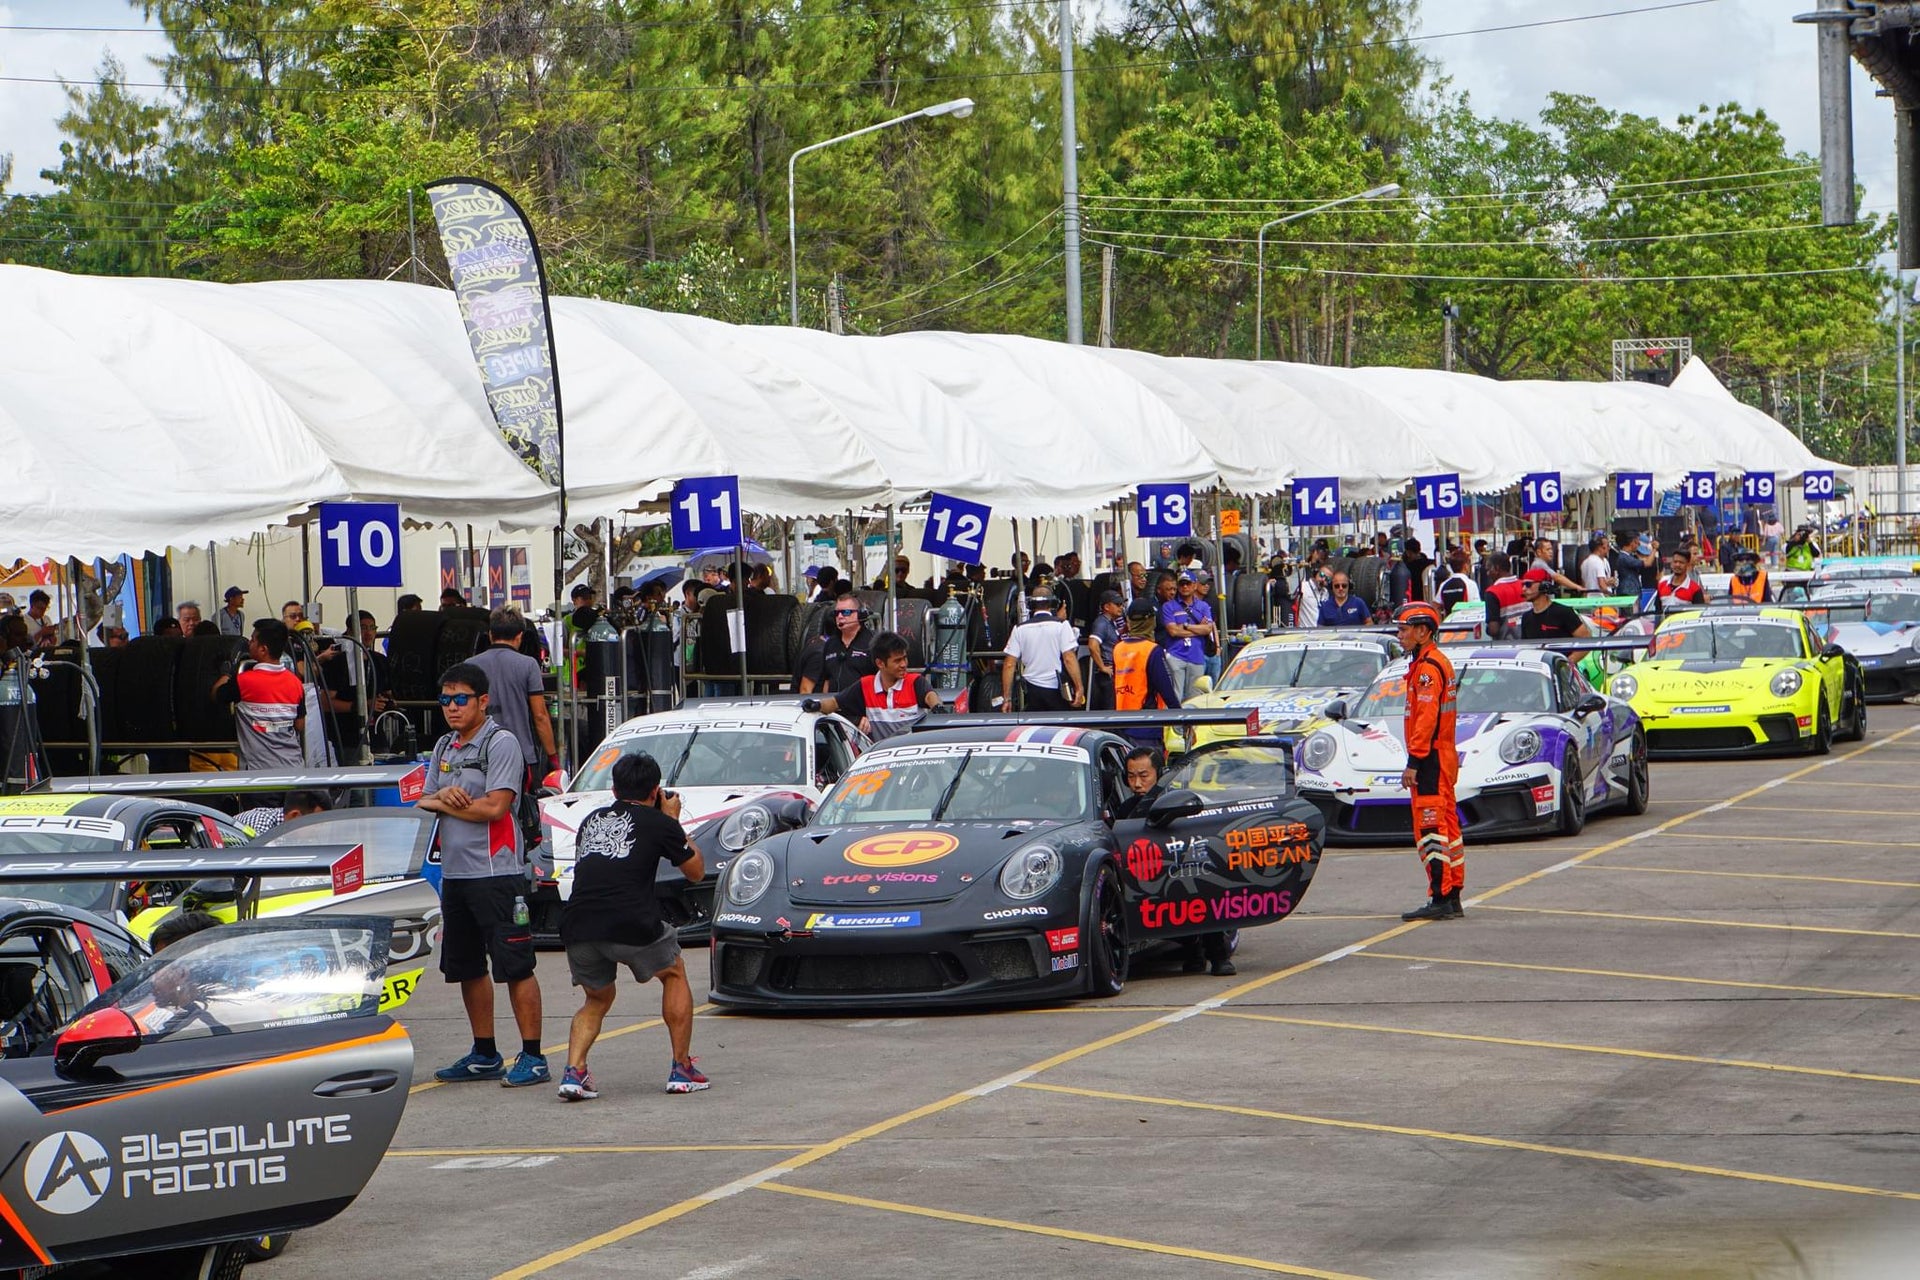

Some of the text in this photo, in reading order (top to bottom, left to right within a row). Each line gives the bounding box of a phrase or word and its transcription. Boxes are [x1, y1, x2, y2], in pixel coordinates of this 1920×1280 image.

[1524, 479, 1558, 503] 16
[1620, 480, 1650, 500] 17
[1683, 478, 1713, 499] 18
[1745, 478, 1772, 496] 19
[1805, 476, 1832, 493] 20
[1296, 487, 1335, 514] 14
[1419, 482, 1458, 510] 15
[680, 491, 731, 531] 11
[1142, 495, 1186, 524] 13
[932, 509, 982, 550] 12
[328, 521, 393, 566] 10
[1230, 658, 1267, 679] 93
[612, 720, 793, 740] PORSCHE
[865, 744, 1079, 762] PORSCHE
[66, 773, 389, 791] PORSCHE
[835, 769, 892, 803] 78
[1484, 772, 1530, 784] CHOPARD
[1227, 801, 1274, 813] HUNTER
[1, 817, 113, 833] CHE
[1225, 822, 1311, 850] 中国平安
[860, 838, 946, 857] CP
[1165, 835, 1210, 868] 中信
[823, 871, 939, 886] true visions
[1168, 861, 1212, 878] CITIC
[983, 906, 1049, 920] CHOPARD
[1140, 888, 1291, 928] true visions
[716, 913, 762, 926] CHOPARD
[836, 915, 911, 925] MICHELIN
